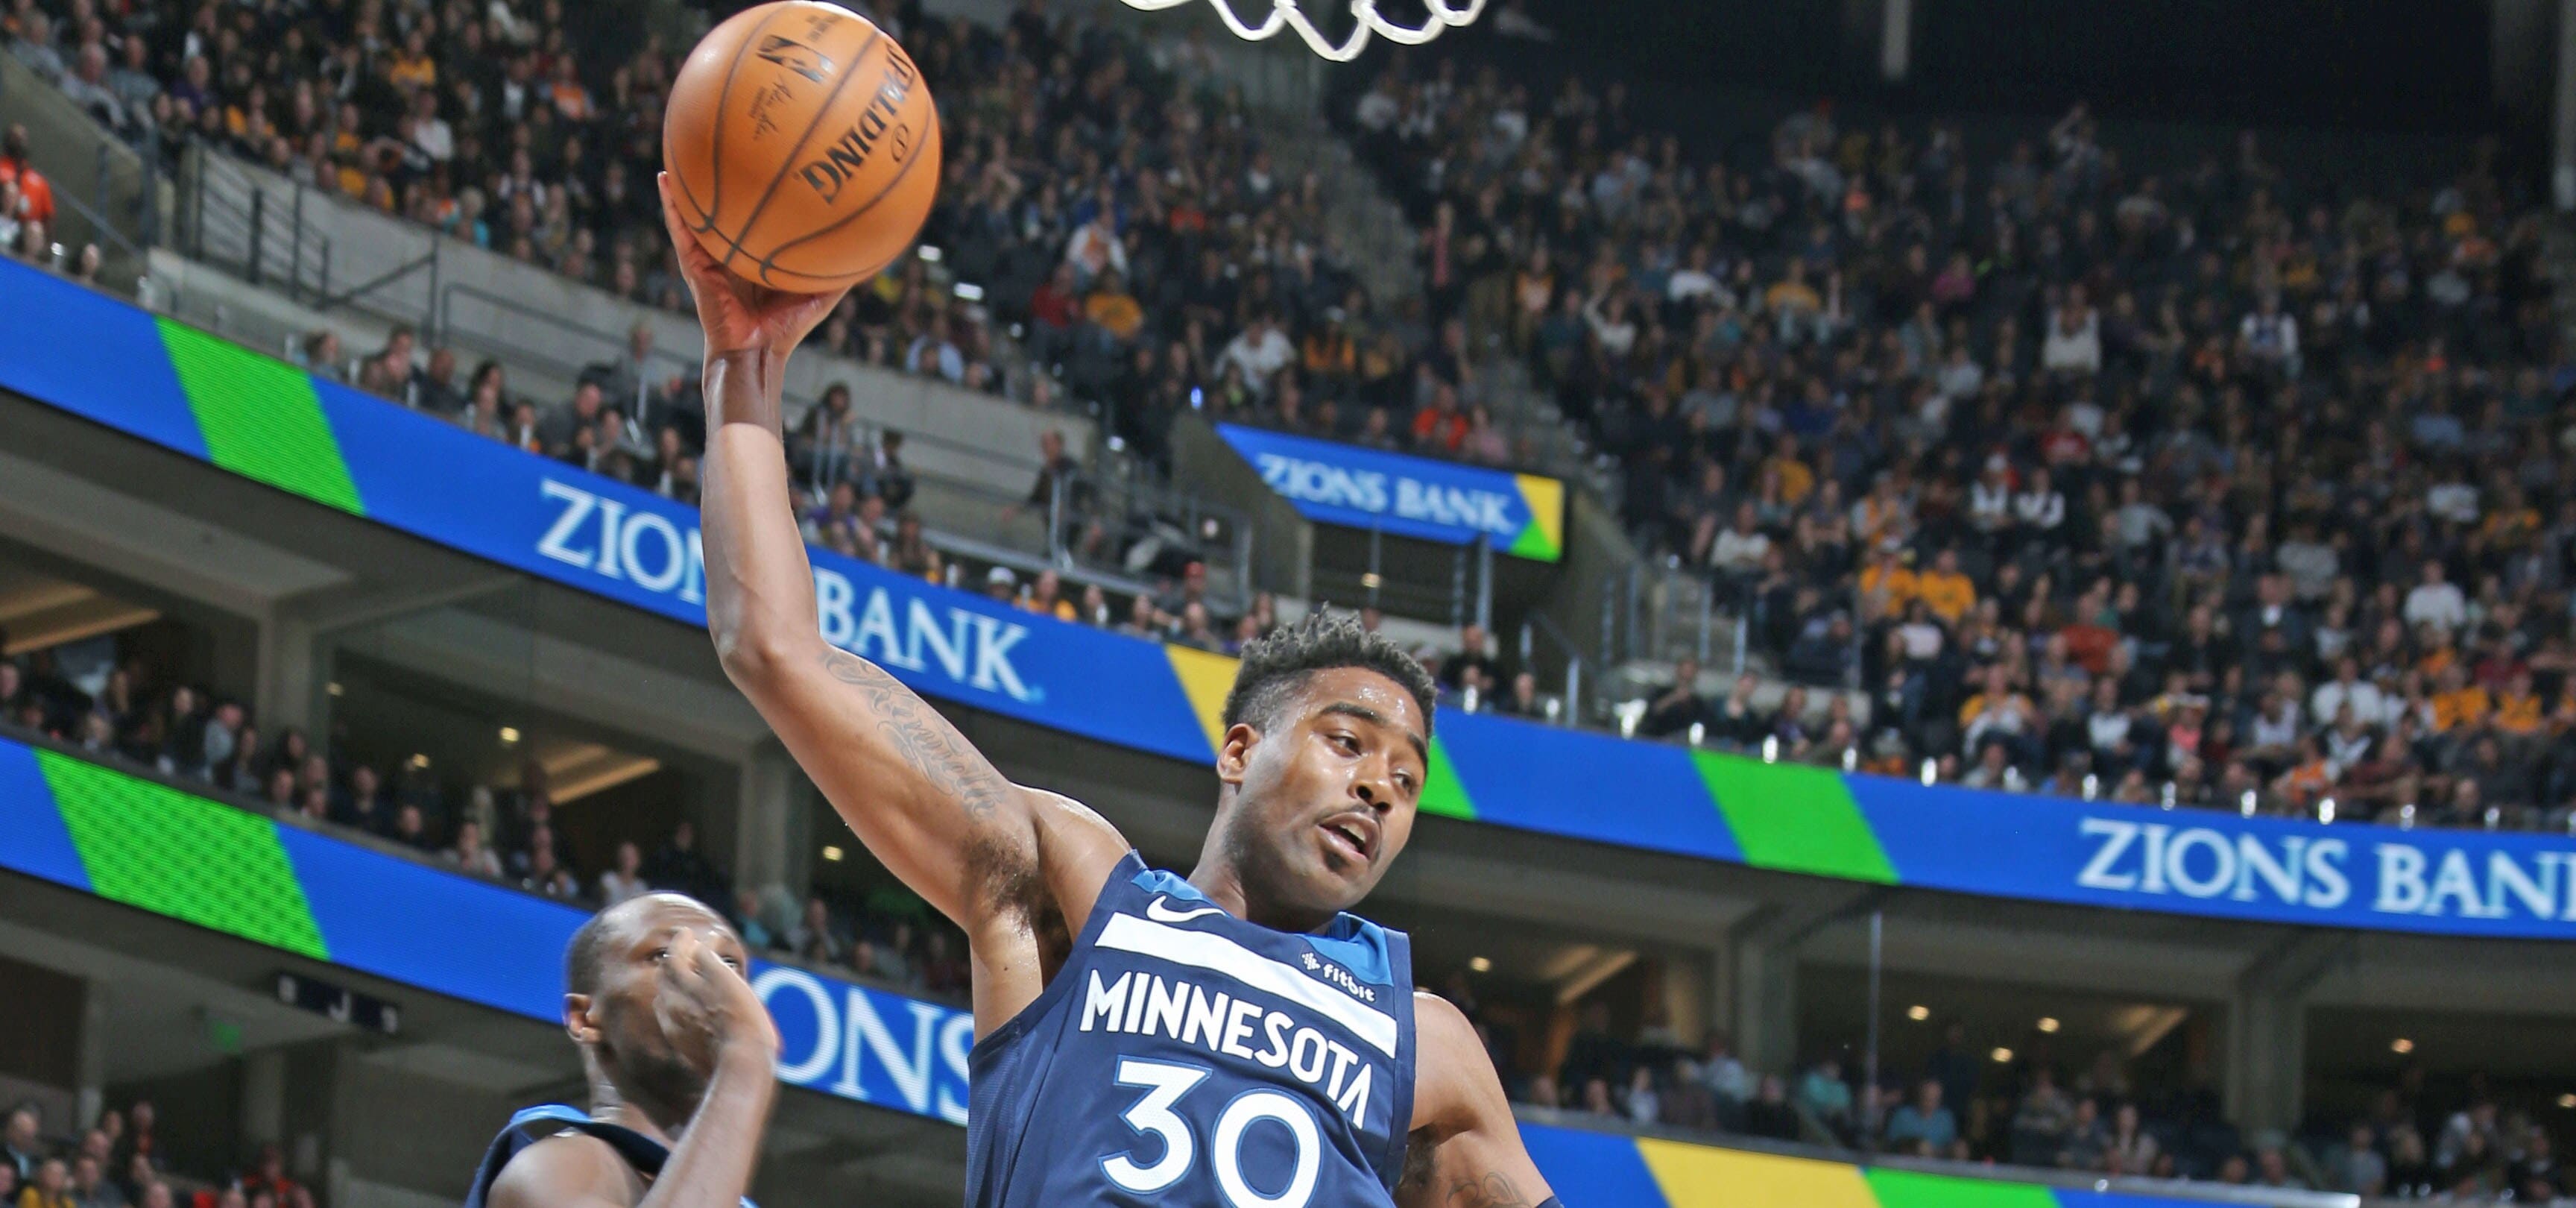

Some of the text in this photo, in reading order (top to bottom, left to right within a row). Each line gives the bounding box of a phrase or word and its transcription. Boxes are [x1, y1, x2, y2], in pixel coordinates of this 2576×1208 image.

[801, 42, 915, 204] SPALDING
[1257, 453, 1517, 535] ZIONS BANK
[813, 565, 1030, 702] BANK
[2077, 817, 2576, 922] ZIONS BAN
[1079, 969, 1372, 1130] MINNESOTA
[1323, 963, 1375, 1002] fitbit
[1098, 1054, 1323, 1208] 30
